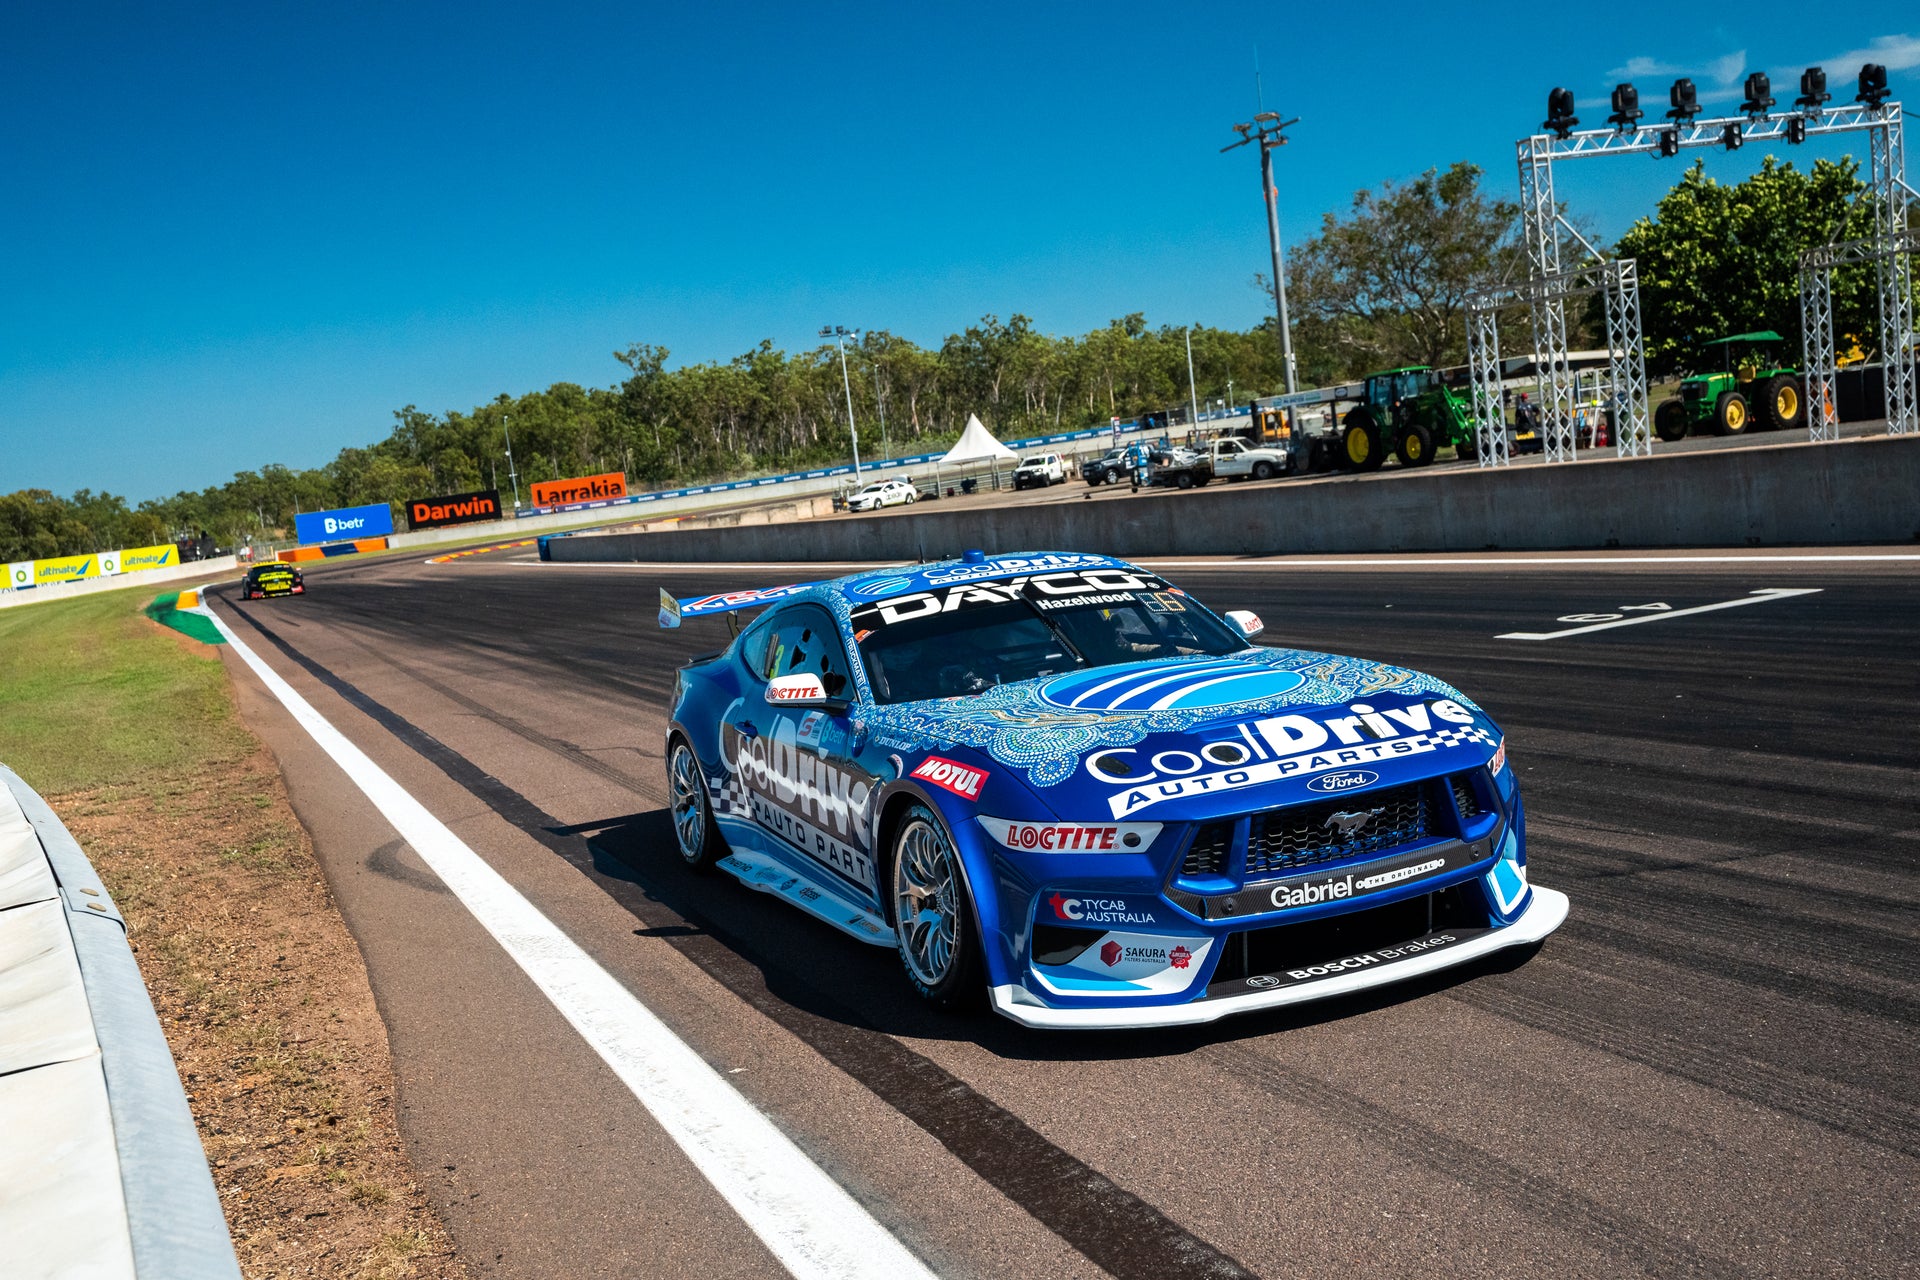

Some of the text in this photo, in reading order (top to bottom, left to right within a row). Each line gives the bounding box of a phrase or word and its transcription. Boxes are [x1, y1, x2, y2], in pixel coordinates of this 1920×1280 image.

[537, 480, 622, 504] Larrakia
[413, 497, 494, 522] Darwin
[338, 517, 364, 530] betr
[39, 565, 77, 576] ultimate
[876, 569, 1148, 625] DAYCO
[1035, 591, 1136, 610] Hazelwood
[846, 639, 866, 686] TRUCKMATE
[767, 687, 818, 699] LOCTITE
[880, 736, 911, 751] DUNLOP
[1086, 699, 1475, 785] CoolDrive
[719, 697, 871, 849] CoolDrive
[914, 760, 981, 796] MOTUL
[1125, 741, 1413, 811] AUTO PARTS
[764, 806, 806, 844] AUTO
[1007, 825, 1117, 850] LOCTITE
[1270, 863, 1434, 908] Gabriel THE ORIGINAL
[1083, 899, 1126, 910] TYCAB
[1086, 912, 1155, 923] AUSTRALIA
[1125, 947, 1166, 958] SAKURA
[1286, 933, 1457, 980] BOSCH Brakes
